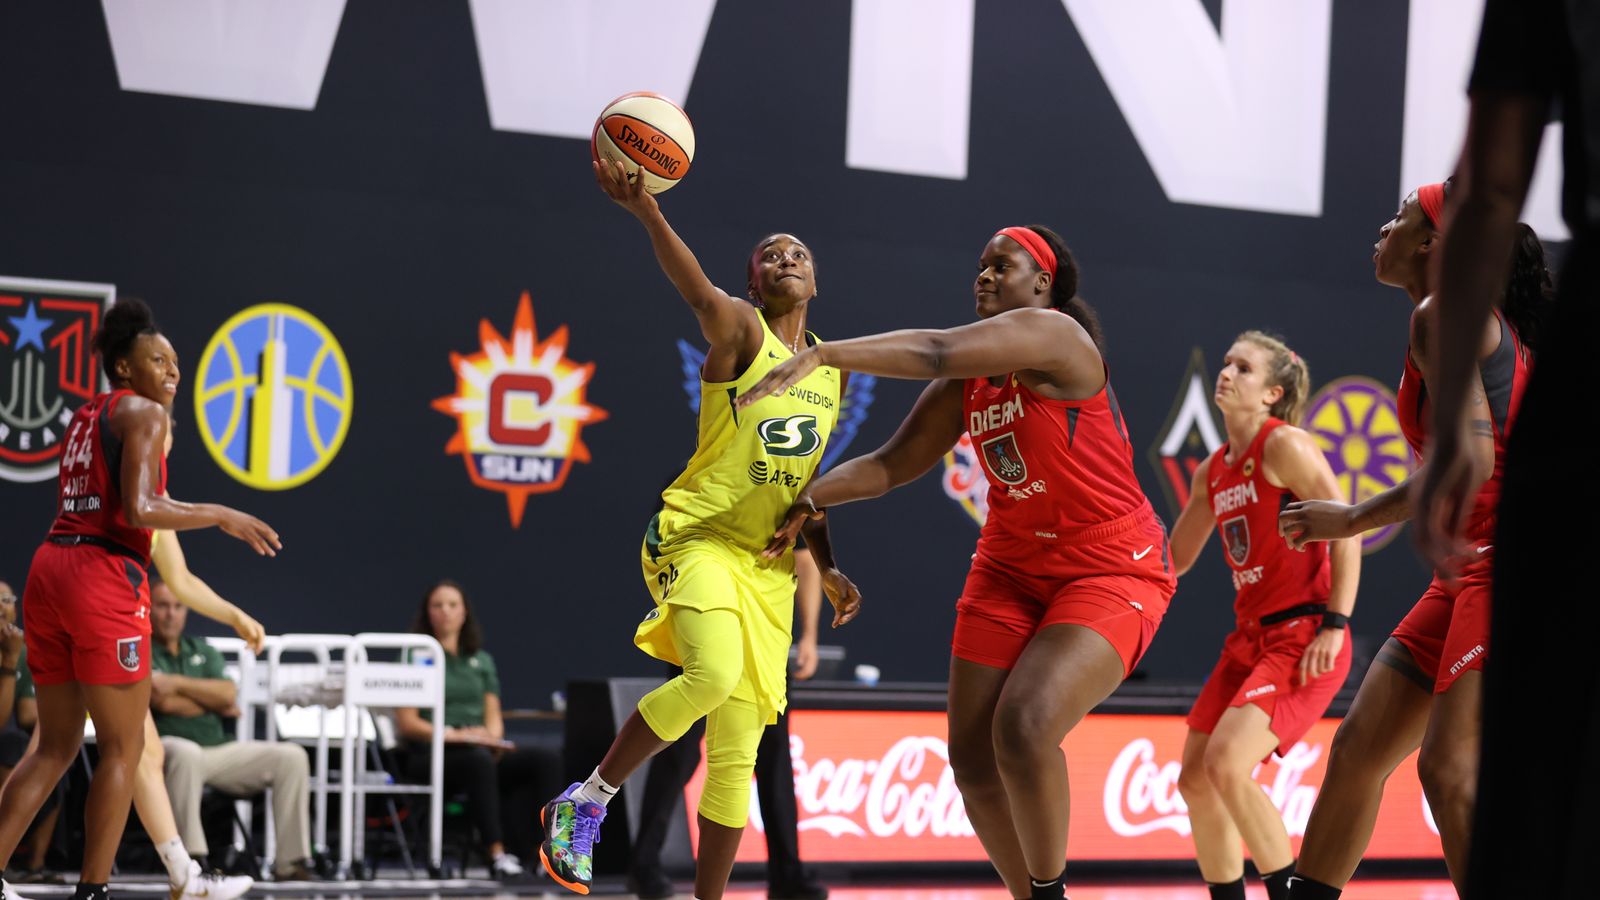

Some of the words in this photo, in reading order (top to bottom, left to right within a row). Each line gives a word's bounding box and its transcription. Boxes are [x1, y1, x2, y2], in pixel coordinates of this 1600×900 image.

[617, 125, 681, 175] SPALDING
[789, 385, 834, 410] SWEDISH
[63, 417, 94, 472] 44
[481, 454, 554, 482] SUN
[1214, 480, 1258, 516] DREAM
[1450, 644, 1484, 675] ATLANTA
[1245, 684, 1276, 698] ATLANTA
[749, 735, 977, 837] ca-Cola
